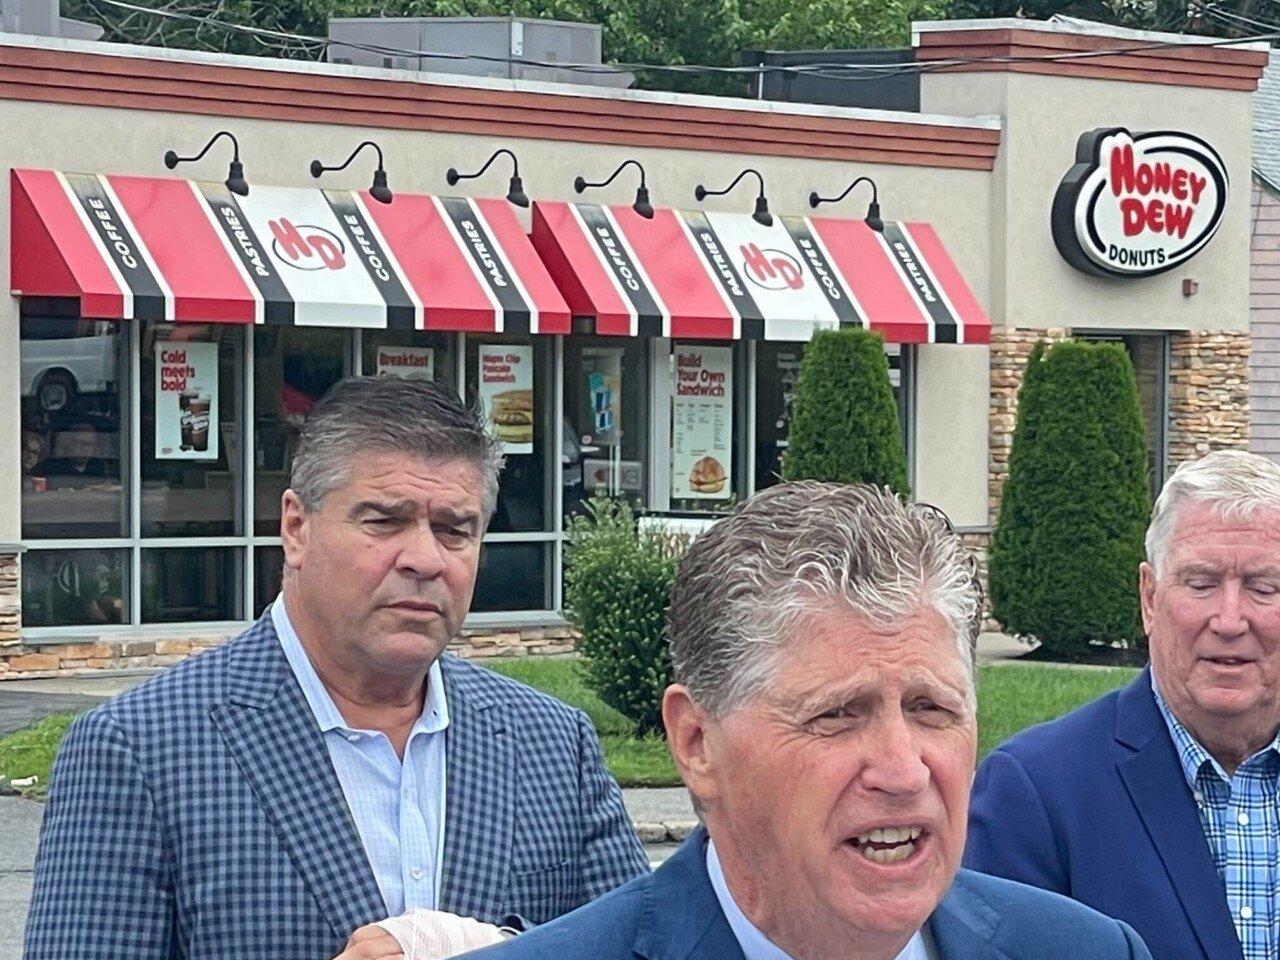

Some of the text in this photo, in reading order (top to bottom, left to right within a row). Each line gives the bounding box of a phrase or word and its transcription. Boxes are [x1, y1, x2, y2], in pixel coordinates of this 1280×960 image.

[1110, 144, 1206, 205] HONEY
[88, 197, 138, 269] COFFEE
[220, 206, 270, 277] PASTRIES
[1120, 198, 1193, 239] DEW
[343, 214, 390, 282] COFFEE
[461, 220, 508, 287] PASTRIES
[596, 227, 640, 291] COFFEE
[700, 232, 744, 297] PASTRIES
[799, 238, 841, 300] COFFEE
[894, 242, 937, 302] PASTRIES
[1109, 244, 1166, 266] DONUTS
[161, 350, 187, 364] Cold
[161, 366, 196, 378] meets
[379, 352, 429, 367] Breakfast
[677, 370, 725, 382] Your Own
[678, 354, 702, 368] Build
[161, 380, 187, 391] bold
[677, 383, 725, 397] Sandwich
